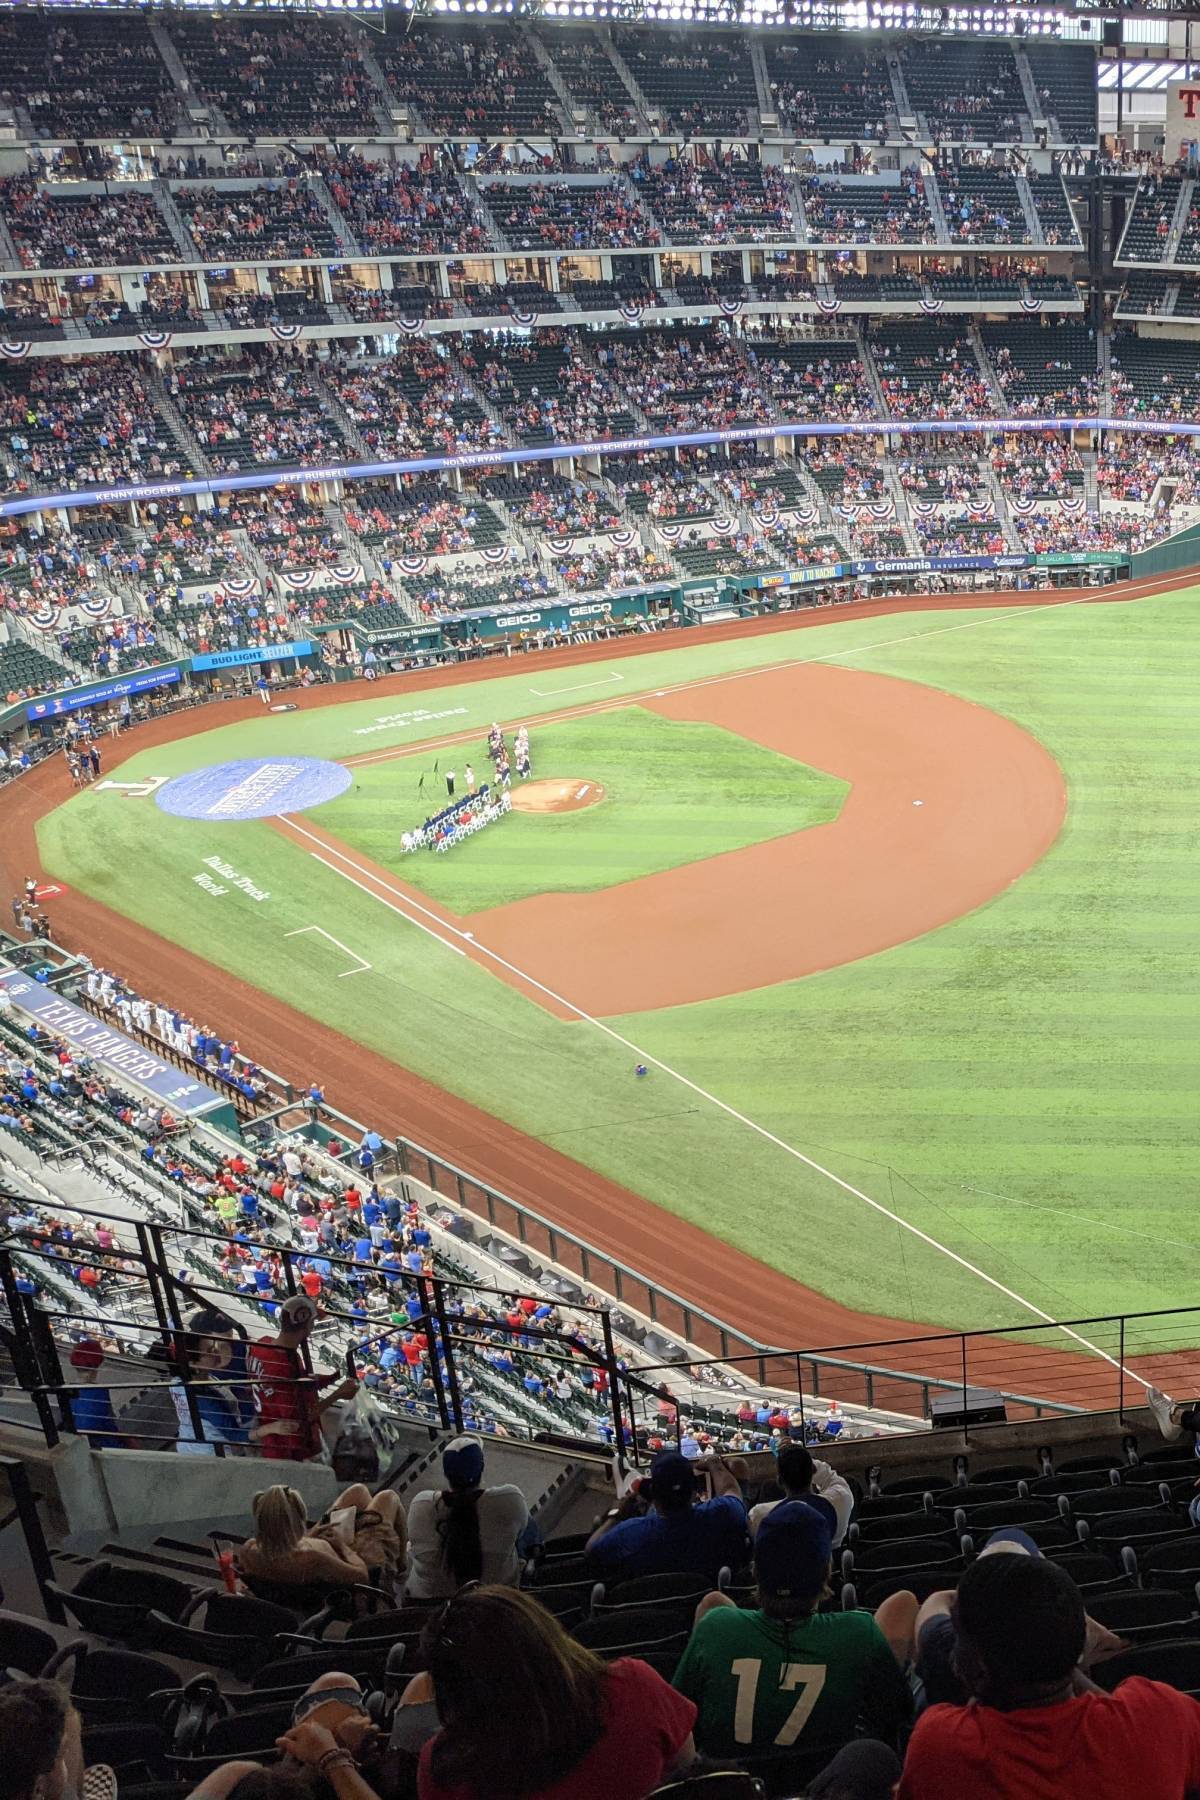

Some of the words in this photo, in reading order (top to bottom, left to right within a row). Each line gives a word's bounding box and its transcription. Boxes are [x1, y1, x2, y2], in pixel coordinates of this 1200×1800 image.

[747, 428, 776, 438] SIERRA
[1107, 421, 1141, 430] MICHAEL
[1144, 423, 1171, 431] YOUNG
[583, 444, 602, 453] TOM
[442, 456, 475, 466] NOLAN
[476, 454, 503, 464] RYAN
[279, 472, 303, 483] JEFF
[304, 469, 349, 481] RUSSELL
[95, 490, 134, 501] KENNY
[135, 486, 181, 499] ROGERS
[875, 560, 931, 572] Germania
[933, 562, 979, 570] INSURANCE
[569, 603, 612, 617] GEICO
[496, 613, 541, 627] GEICO
[211, 656, 232, 665] BUD
[234, 651, 262, 662] LIGHT
[192, 872, 229, 897] World
[202, 855, 239, 880] Dallas
[233, 877, 271, 901] Truck
[34, 1000, 97, 1036] TEXAS
[82, 1031, 168, 1080] RANGERS
[730, 1658, 827, 1745] 17
